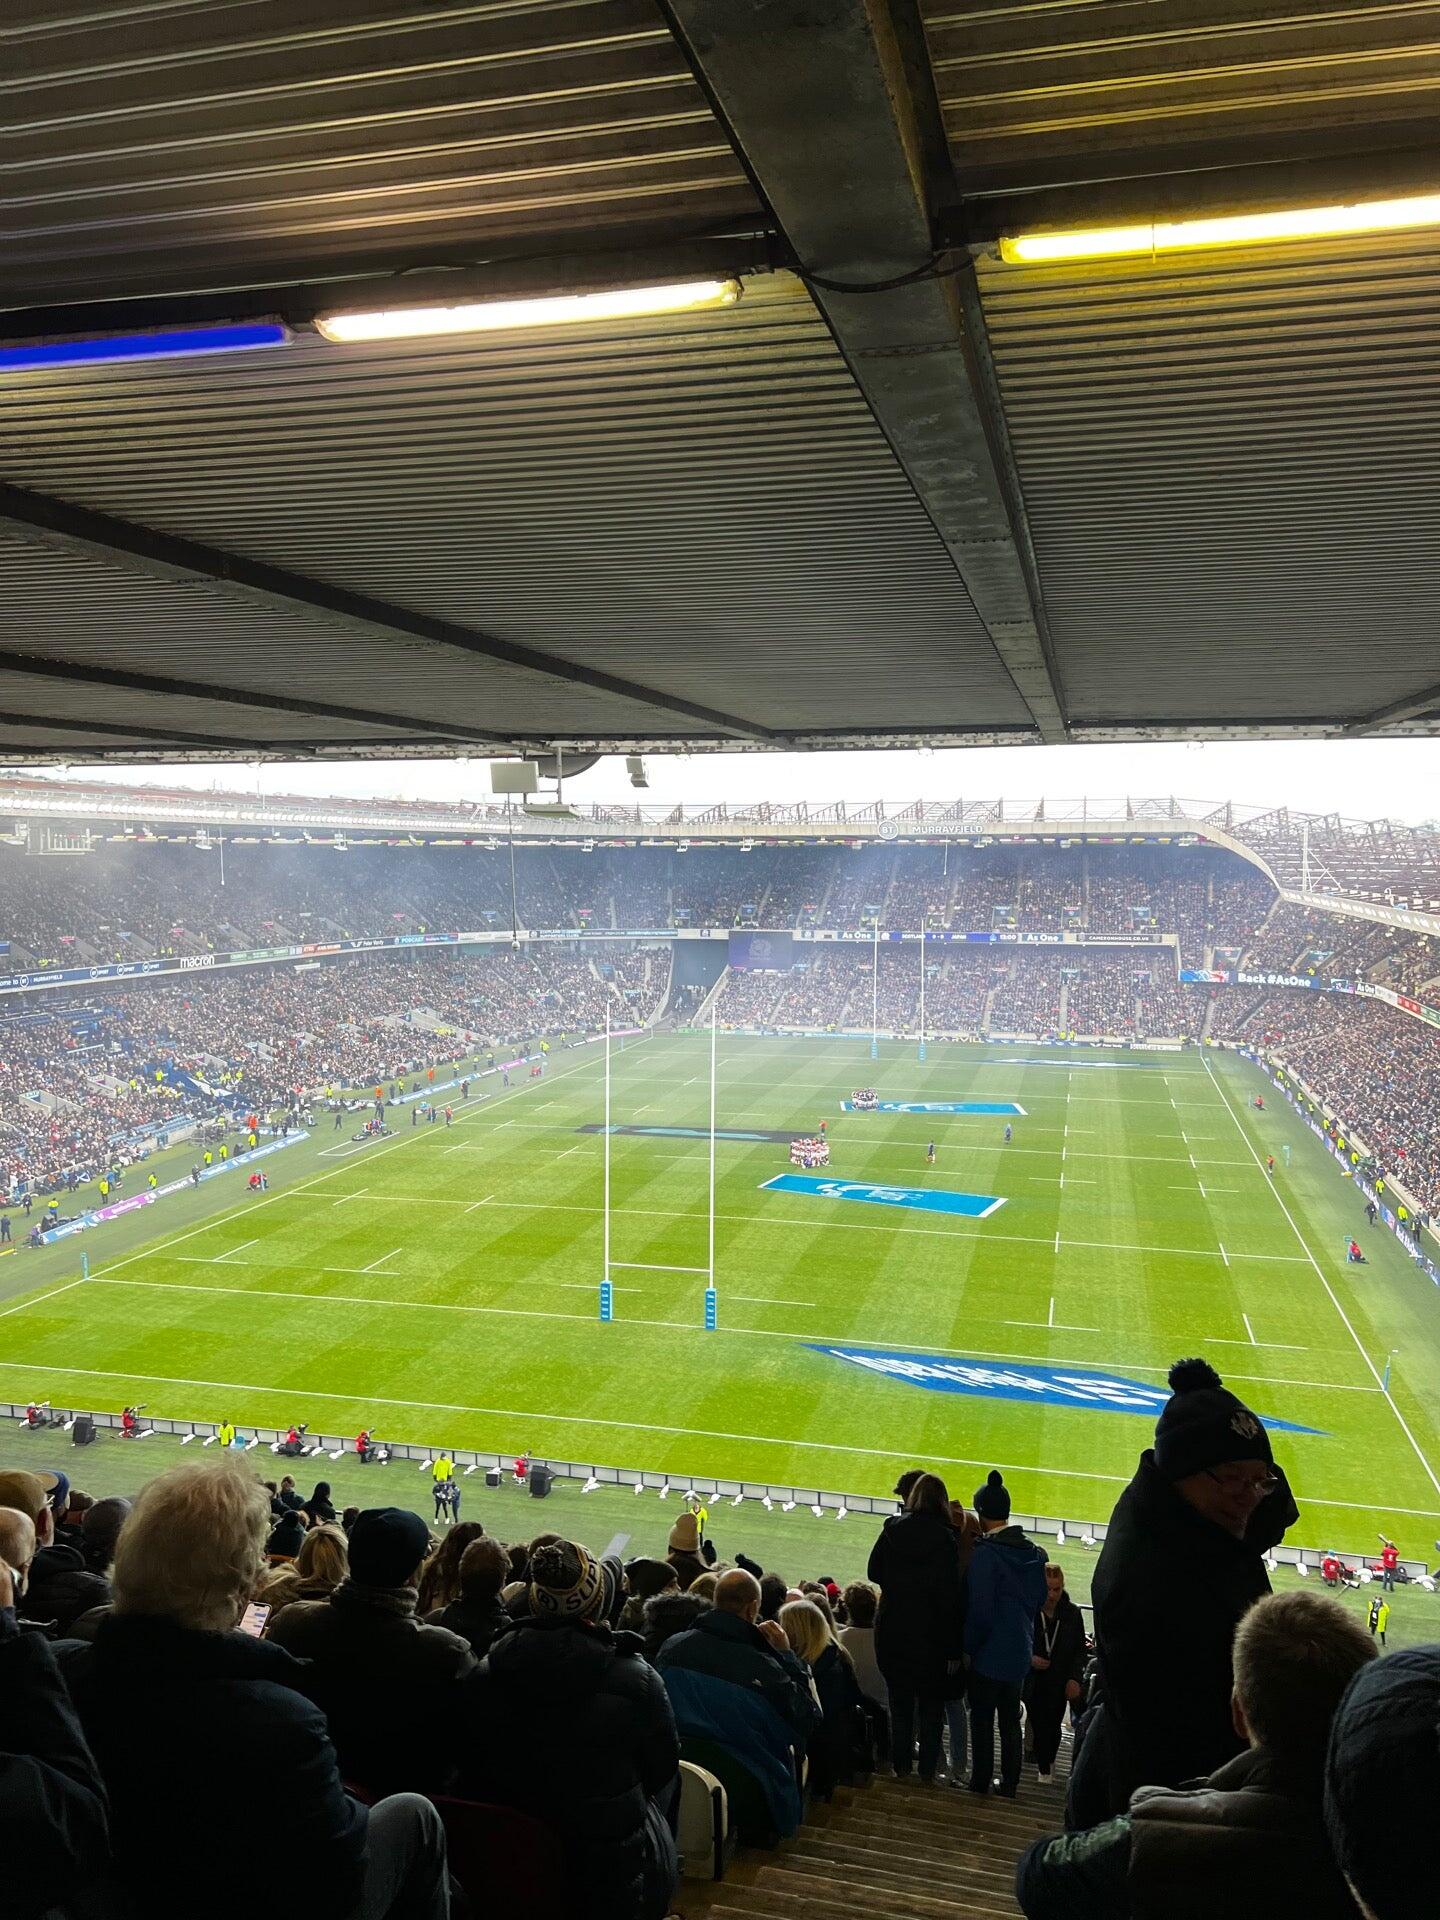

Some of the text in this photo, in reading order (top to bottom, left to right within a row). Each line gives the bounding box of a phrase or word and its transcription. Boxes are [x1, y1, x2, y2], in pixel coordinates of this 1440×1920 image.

[881, 825, 983, 834] BT MURRAYFIELD
[842, 931, 872, 939] As One
[1039, 933, 1059, 942] One
[180, 955, 215, 969] macron
[1237, 972, 1311, 987] Back #AsOne
